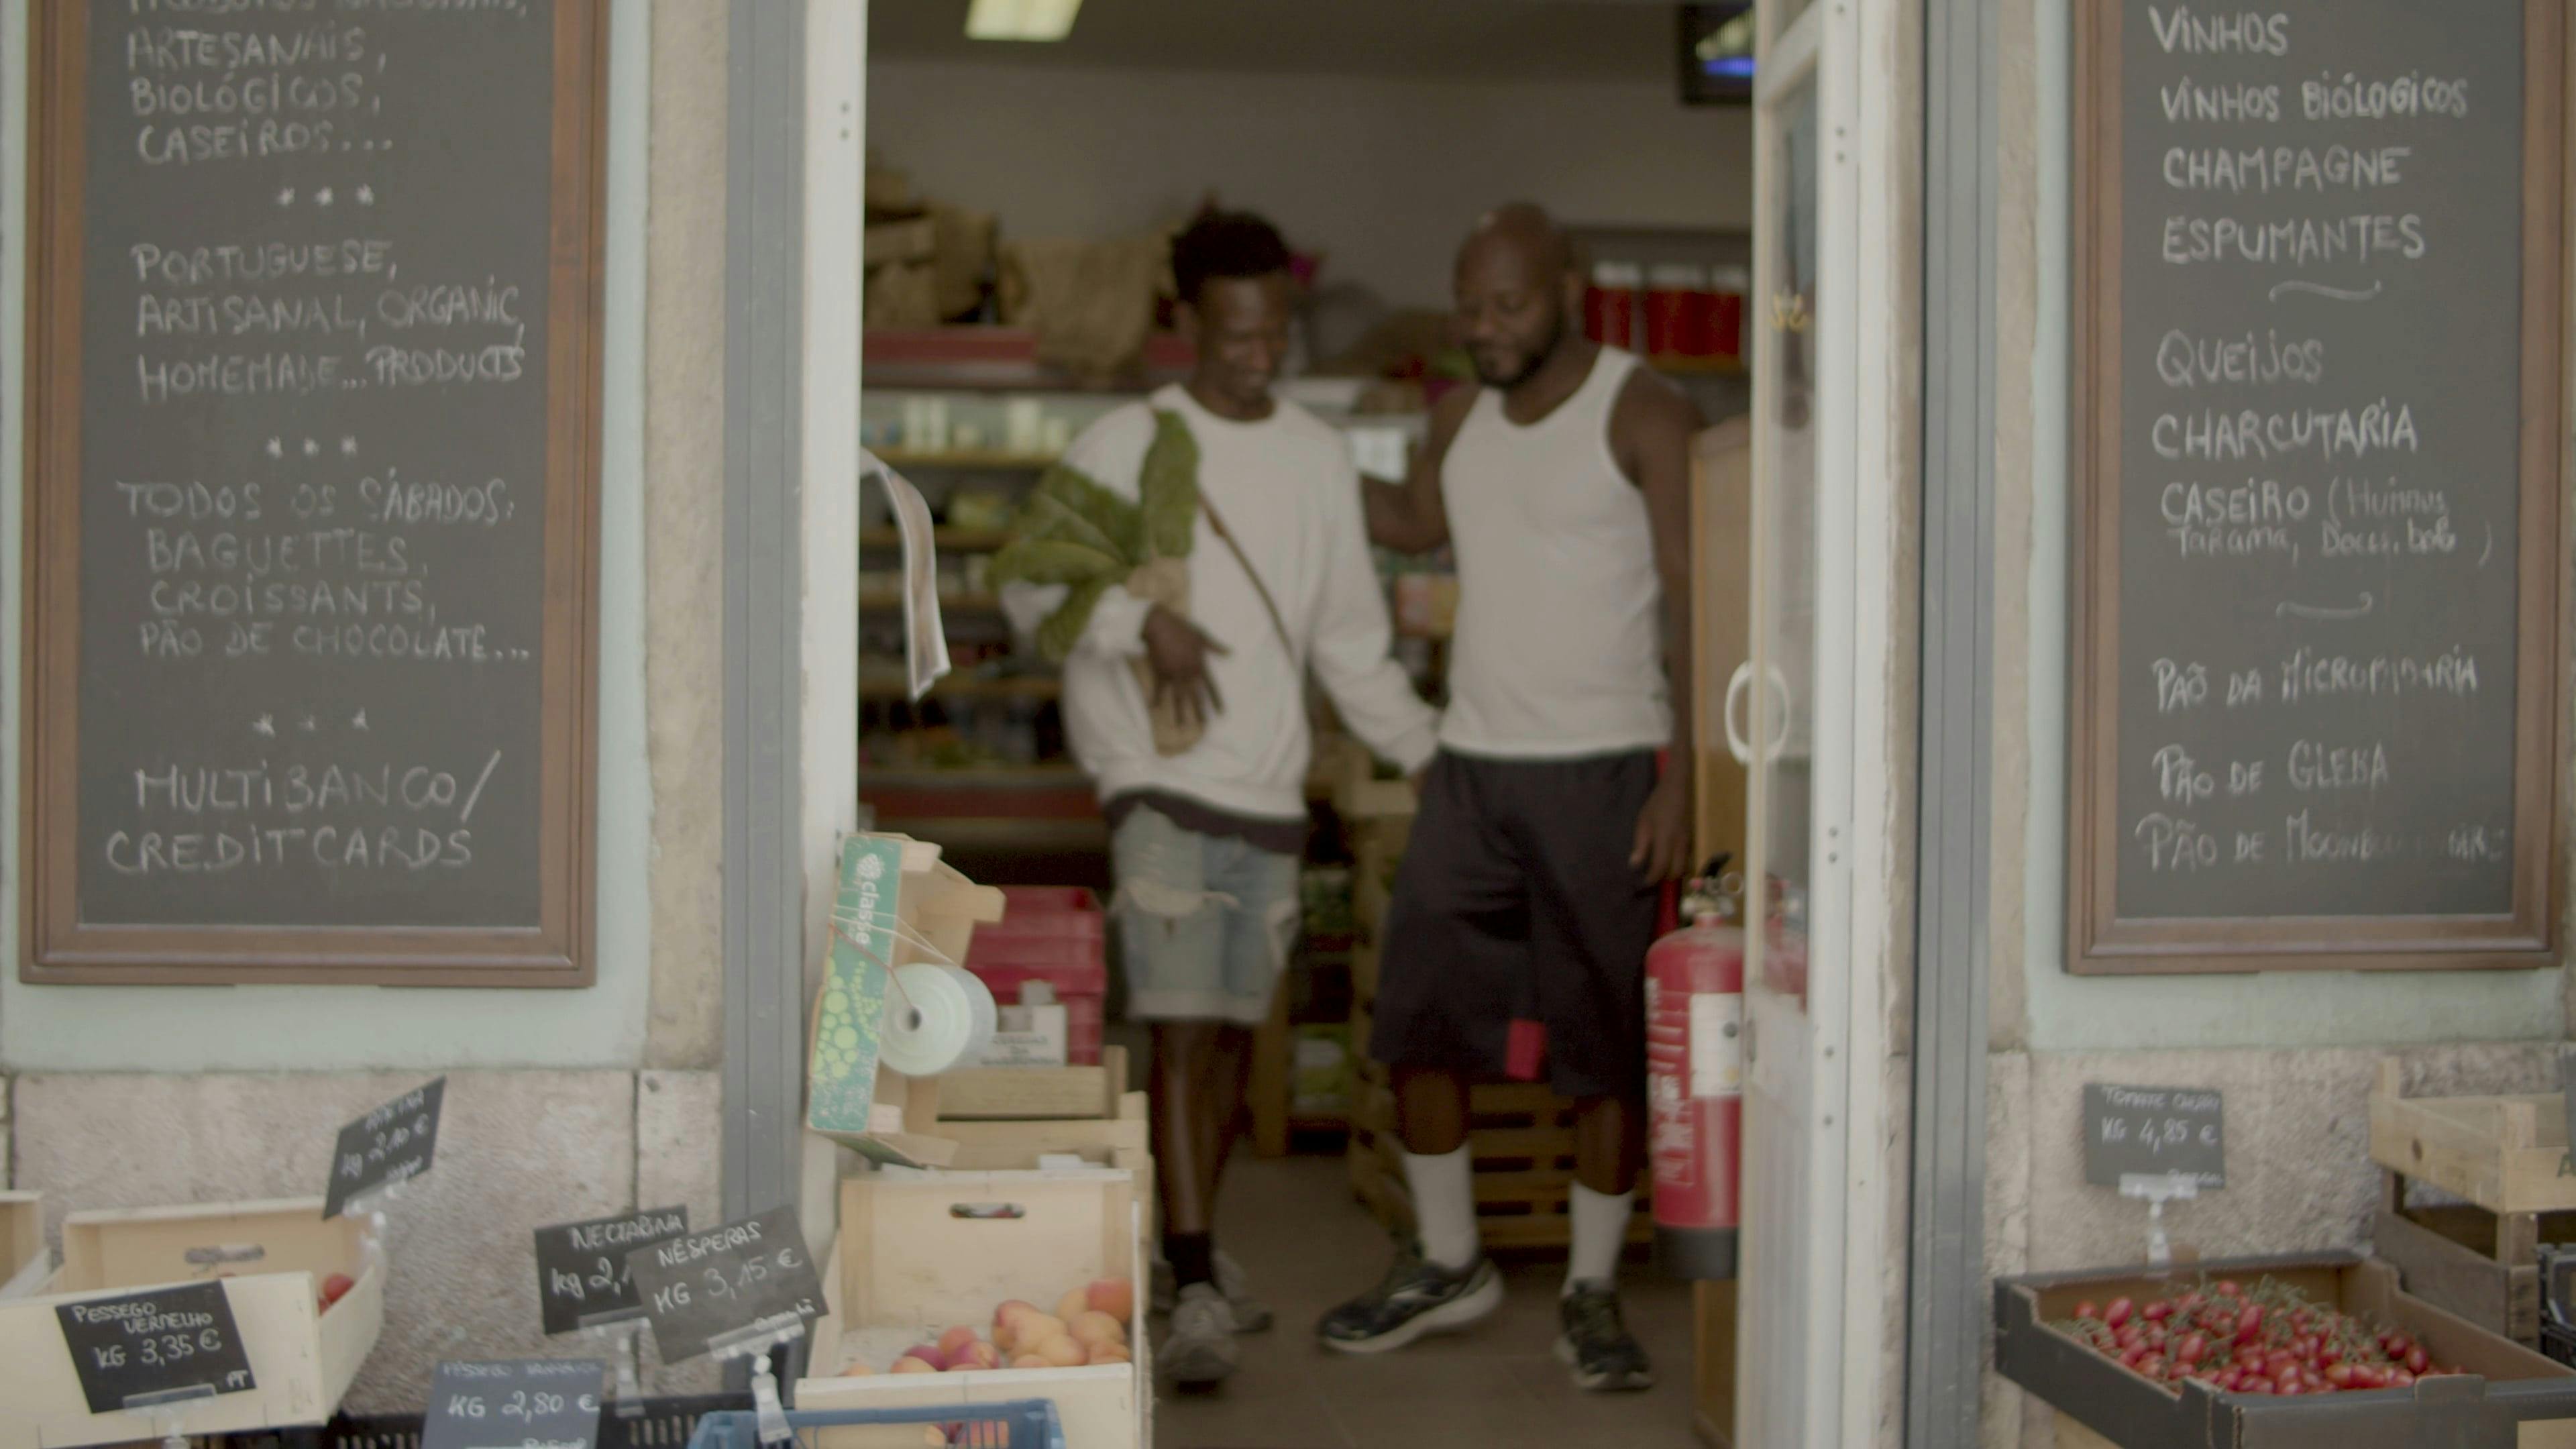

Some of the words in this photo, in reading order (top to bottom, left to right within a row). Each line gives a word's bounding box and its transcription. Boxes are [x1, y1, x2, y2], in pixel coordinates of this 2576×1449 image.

[2148, 3, 2290, 57] VINHOS
[2161, 74, 2280, 123] VINHOS
[2163, 144, 2412, 195] CHAMPAGNE
[2161, 213, 2426, 266] ESPUMANTES
[2156, 328, 2323, 388] QUEIJOS
[2151, 396, 2418, 463] CHARCUTARIA
[116, 478, 260, 520] TODOS
[292, 483, 335, 519] OS
[2161, 476, 2310, 527] CASEIRO
[140, 619, 202, 657] PÃO
[225, 623, 272, 657] DE
[2226, 668, 2262, 708] DA
[2152, 743, 2214, 805] PÃO
[2229, 761, 2263, 794] DE
[2135, 811, 2218, 871] PÃO
[2235, 831, 2264, 862] DE
[855, 881, 879, 946] classe
[654, 1282, 692, 1316] KG
[704, 1256, 767, 1301] 3,15
[777, 1247, 804, 1269] €
[140, 1334, 195, 1366] 3,35
[199, 1327, 222, 1352] €
[447, 1393, 486, 1418] KG
[502, 1390, 565, 1424] 2,80
[578, 1393, 600, 1412] €
